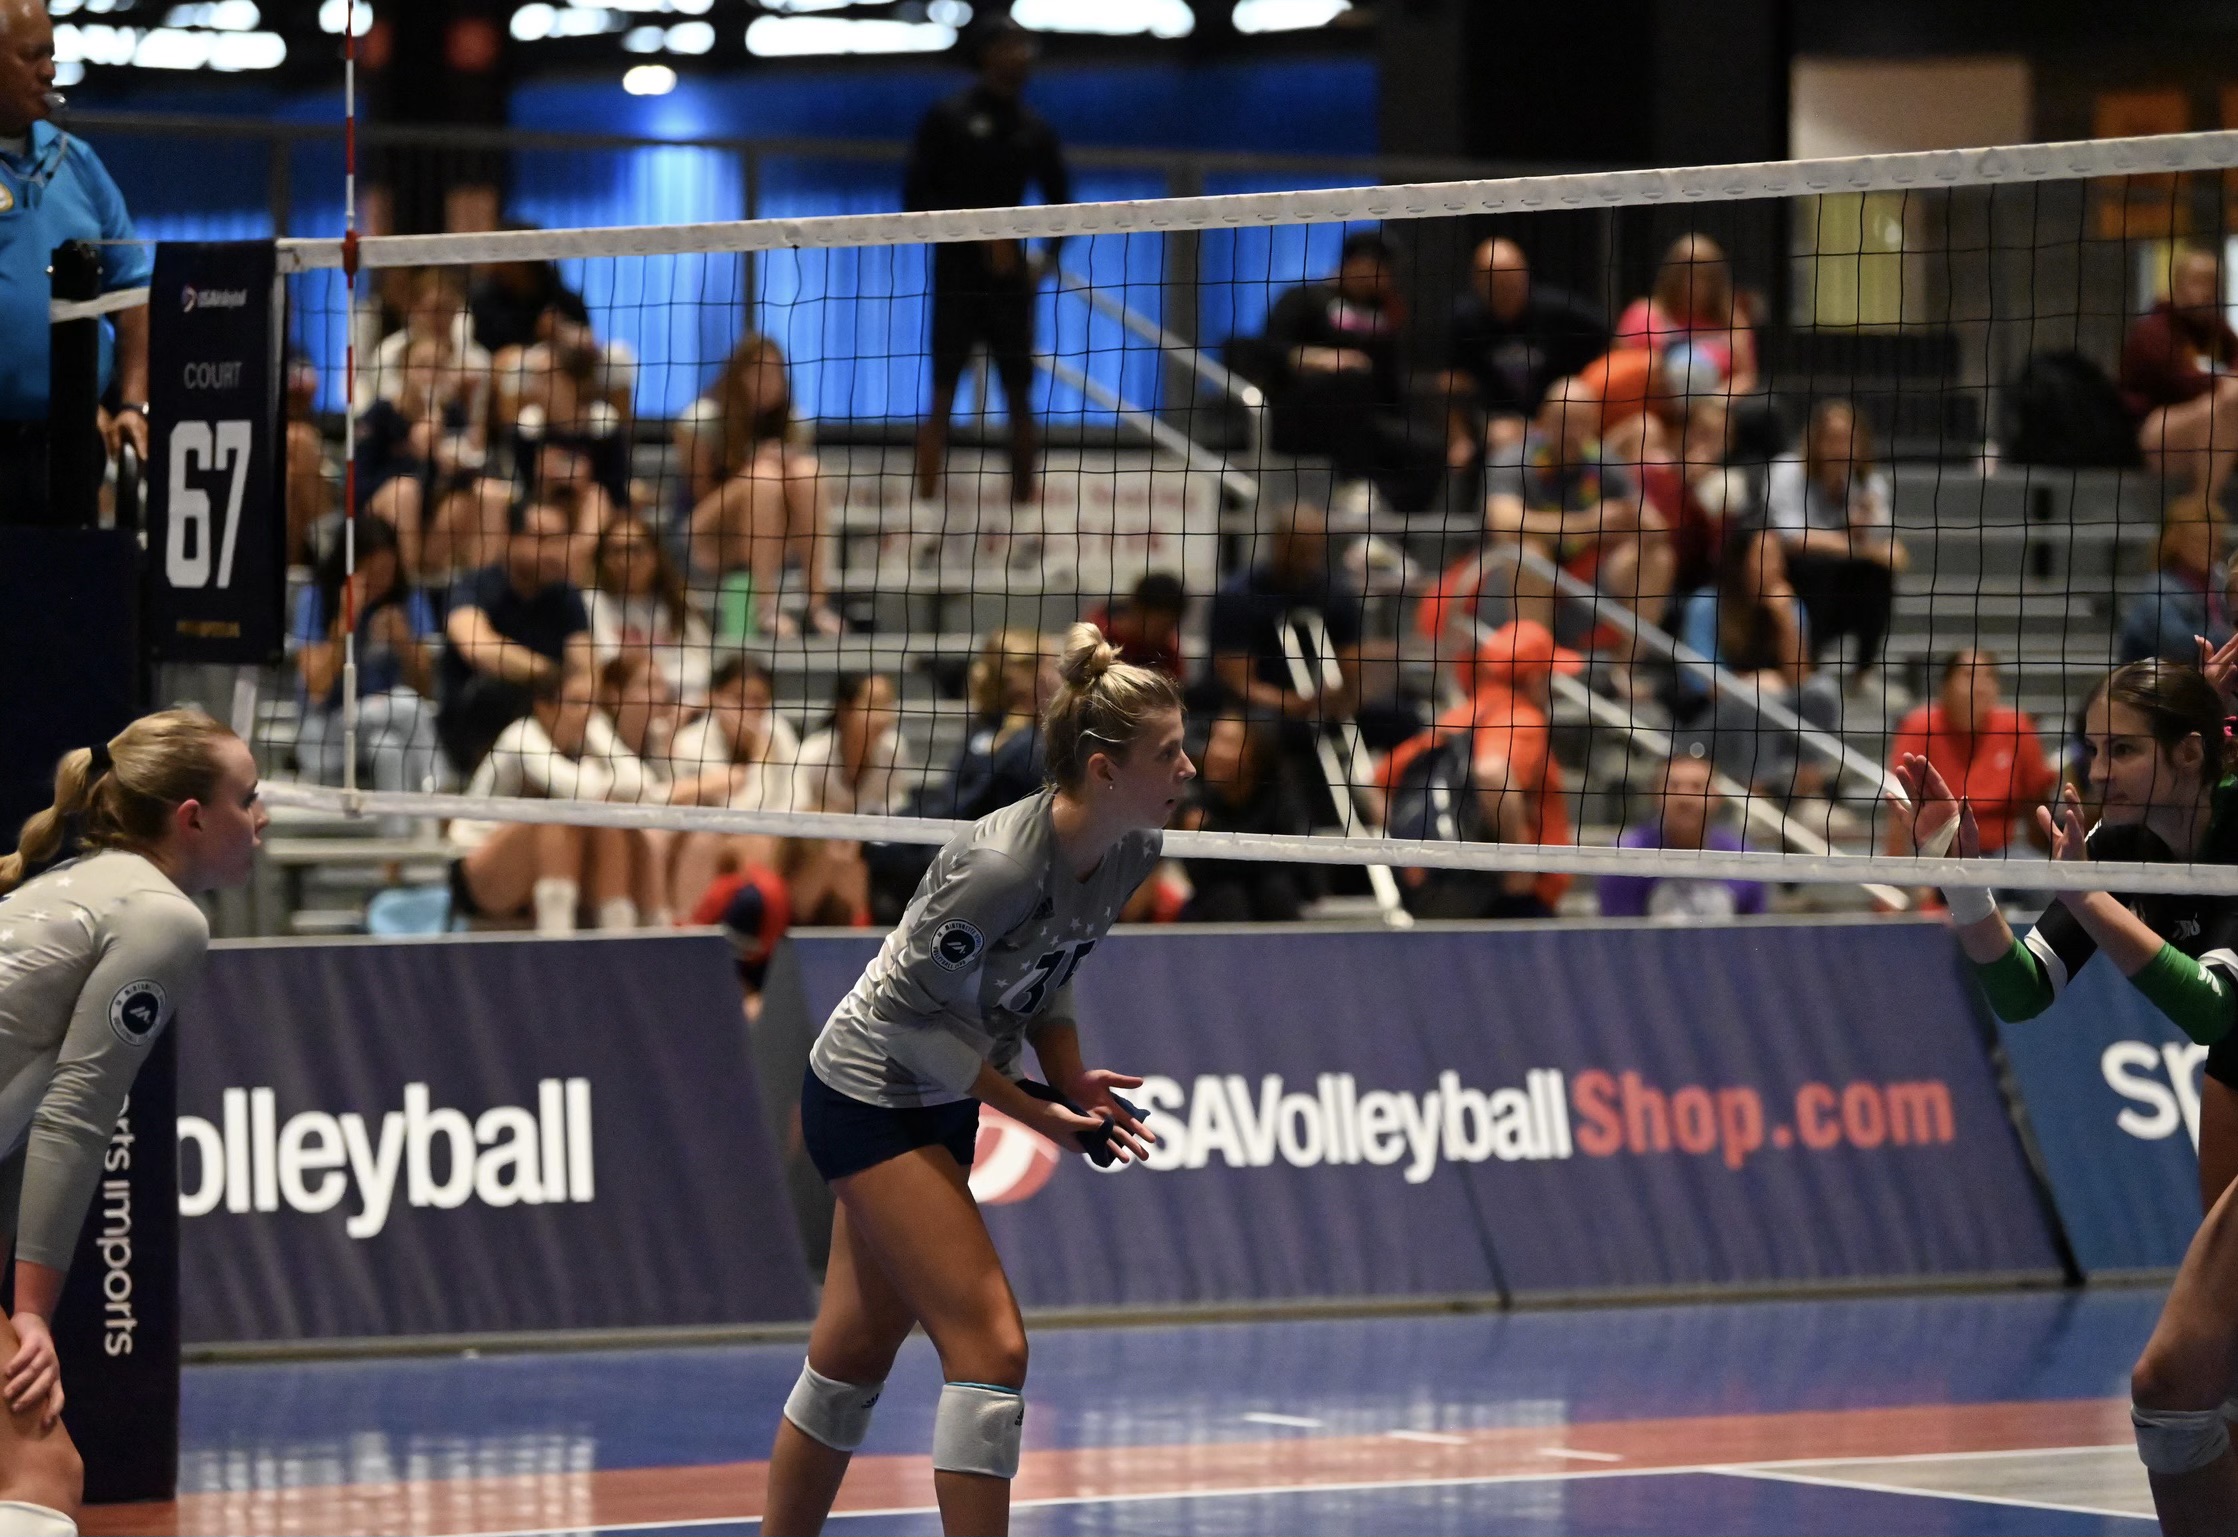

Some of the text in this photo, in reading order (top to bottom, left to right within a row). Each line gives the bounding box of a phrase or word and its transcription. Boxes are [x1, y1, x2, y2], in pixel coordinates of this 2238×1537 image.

[184, 362, 242, 389] COURT
[166, 420, 252, 588] 67
[104, 1093, 136, 1172] rts
[1082, 1067, 1956, 1183] SAVolleyballShop.com
